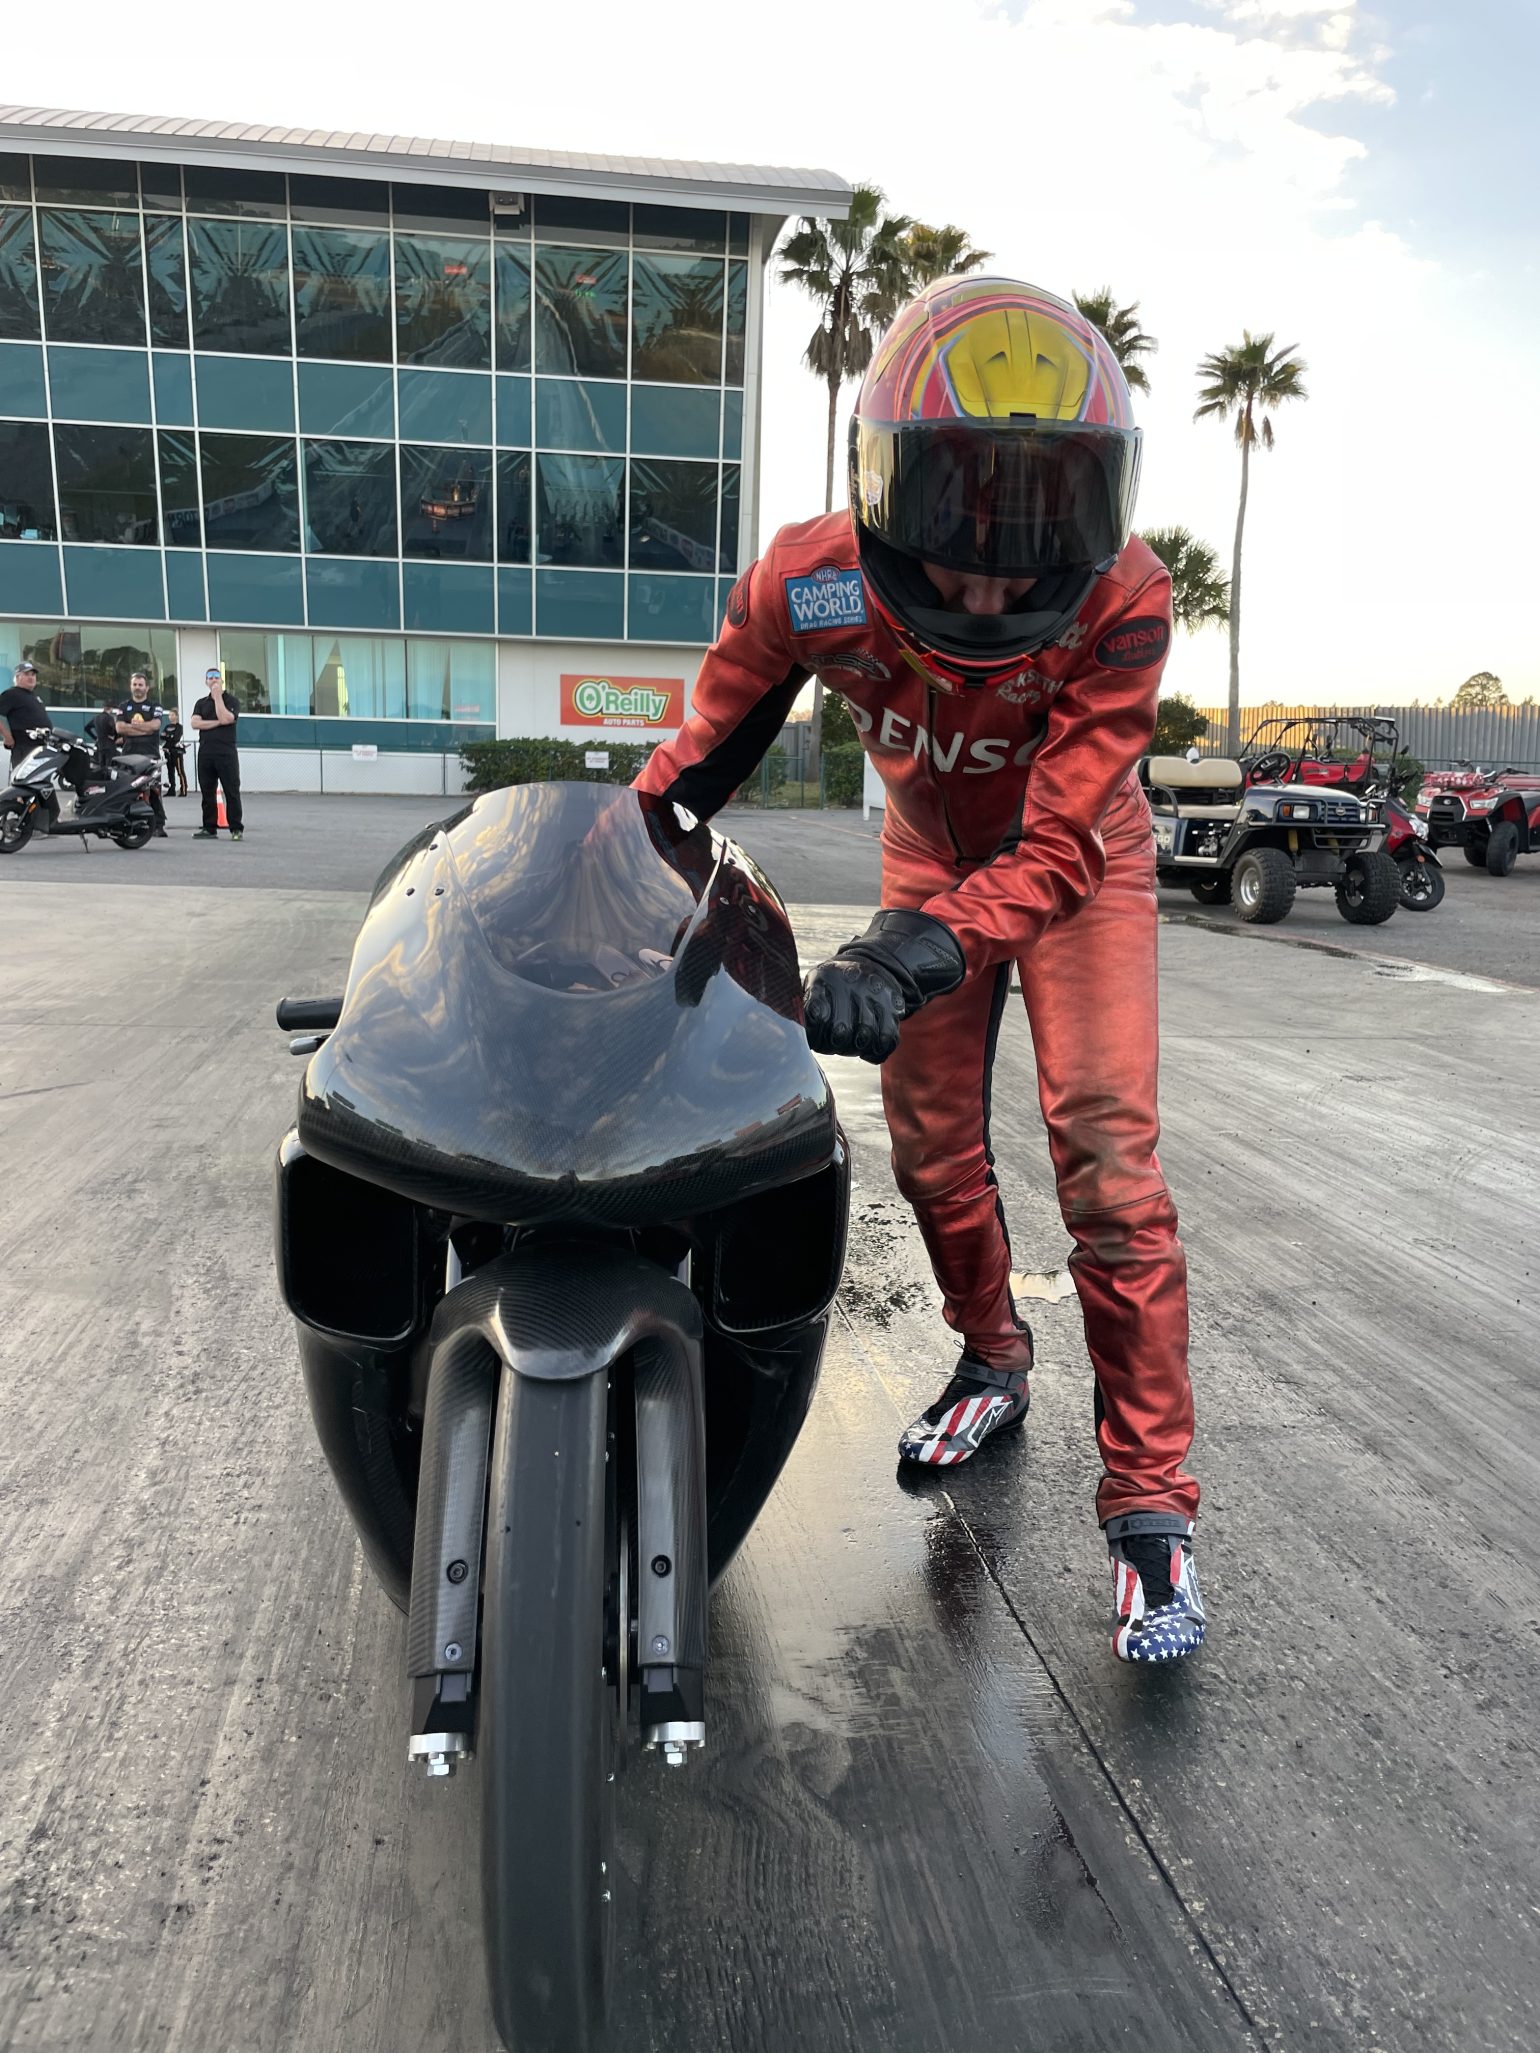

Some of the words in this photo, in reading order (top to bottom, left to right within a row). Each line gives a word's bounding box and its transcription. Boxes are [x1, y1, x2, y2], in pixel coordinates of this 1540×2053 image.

[791, 580, 860, 604] CAMPING
[577, 683, 666, 718] O'Reilly
[602, 718, 621, 726] AUTO
[622, 719, 645, 727] PARTS
